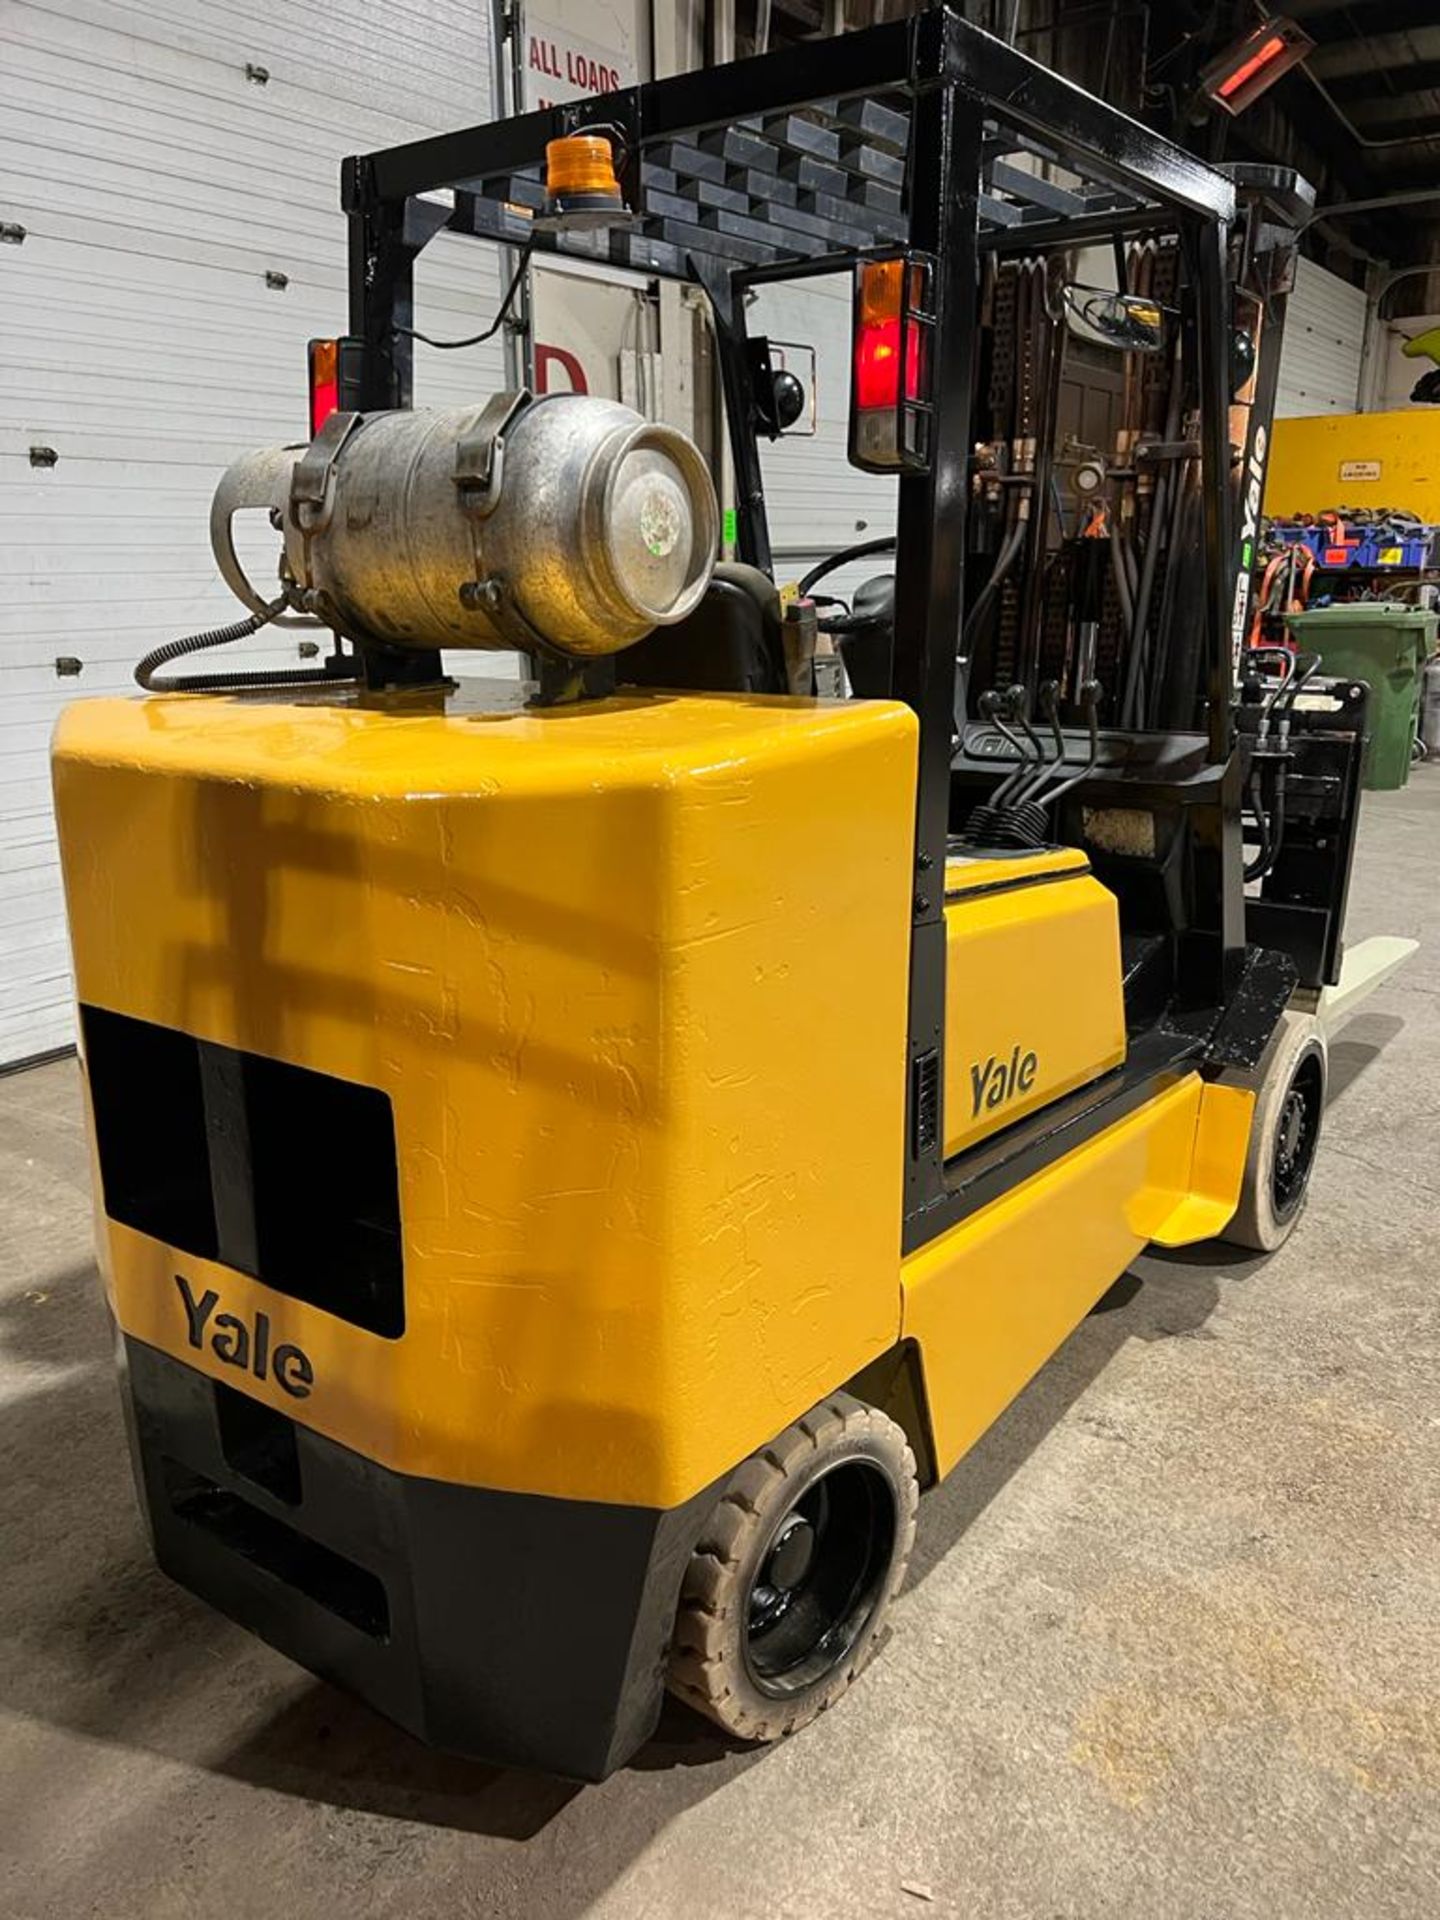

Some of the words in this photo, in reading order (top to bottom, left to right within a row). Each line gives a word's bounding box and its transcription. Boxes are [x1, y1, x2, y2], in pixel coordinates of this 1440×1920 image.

[529, 36, 562, 79] ALL
[567, 51, 620, 94] LOADS
[970, 1045, 1038, 1119] Yale
[174, 1274, 314, 1399] Yale
